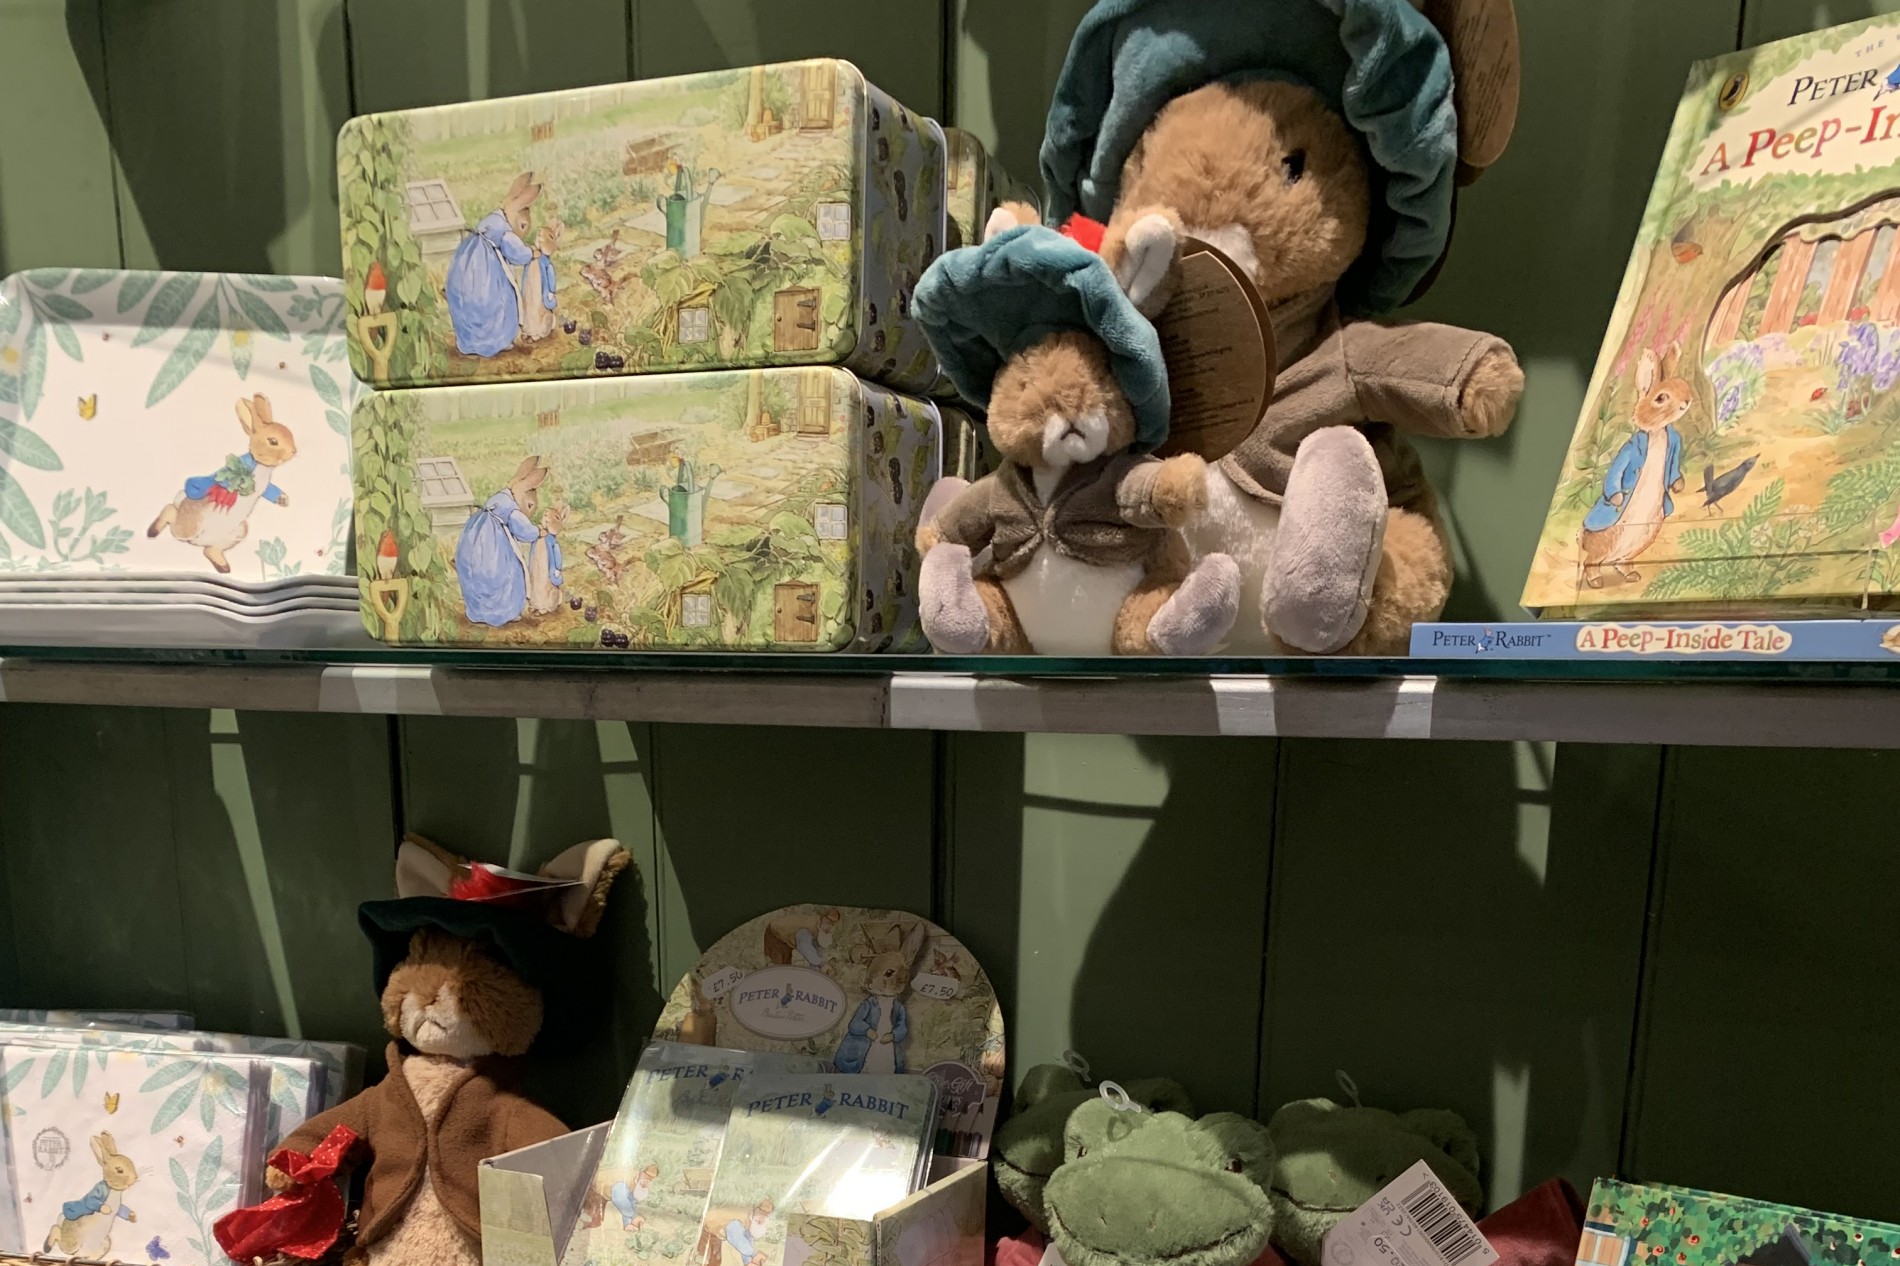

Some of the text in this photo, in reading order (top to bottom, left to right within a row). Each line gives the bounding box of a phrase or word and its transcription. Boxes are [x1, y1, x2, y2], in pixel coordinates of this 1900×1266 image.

[1855, 39, 1885, 57] THE
[1787, 68, 1878, 106] PETER
[1700, 142, 1730, 176] A
[1432, 631, 1476, 647] PETER
[1580, 628, 1785, 651] A Peep-Inside Tale
[712, 971, 743, 993] £7.50
[920, 983, 954, 997] £7.50
[739, 989, 838, 1013] PETER RABBIT
[747, 1092, 812, 1117] PETER
[839, 1093, 909, 1119] RABBIT
